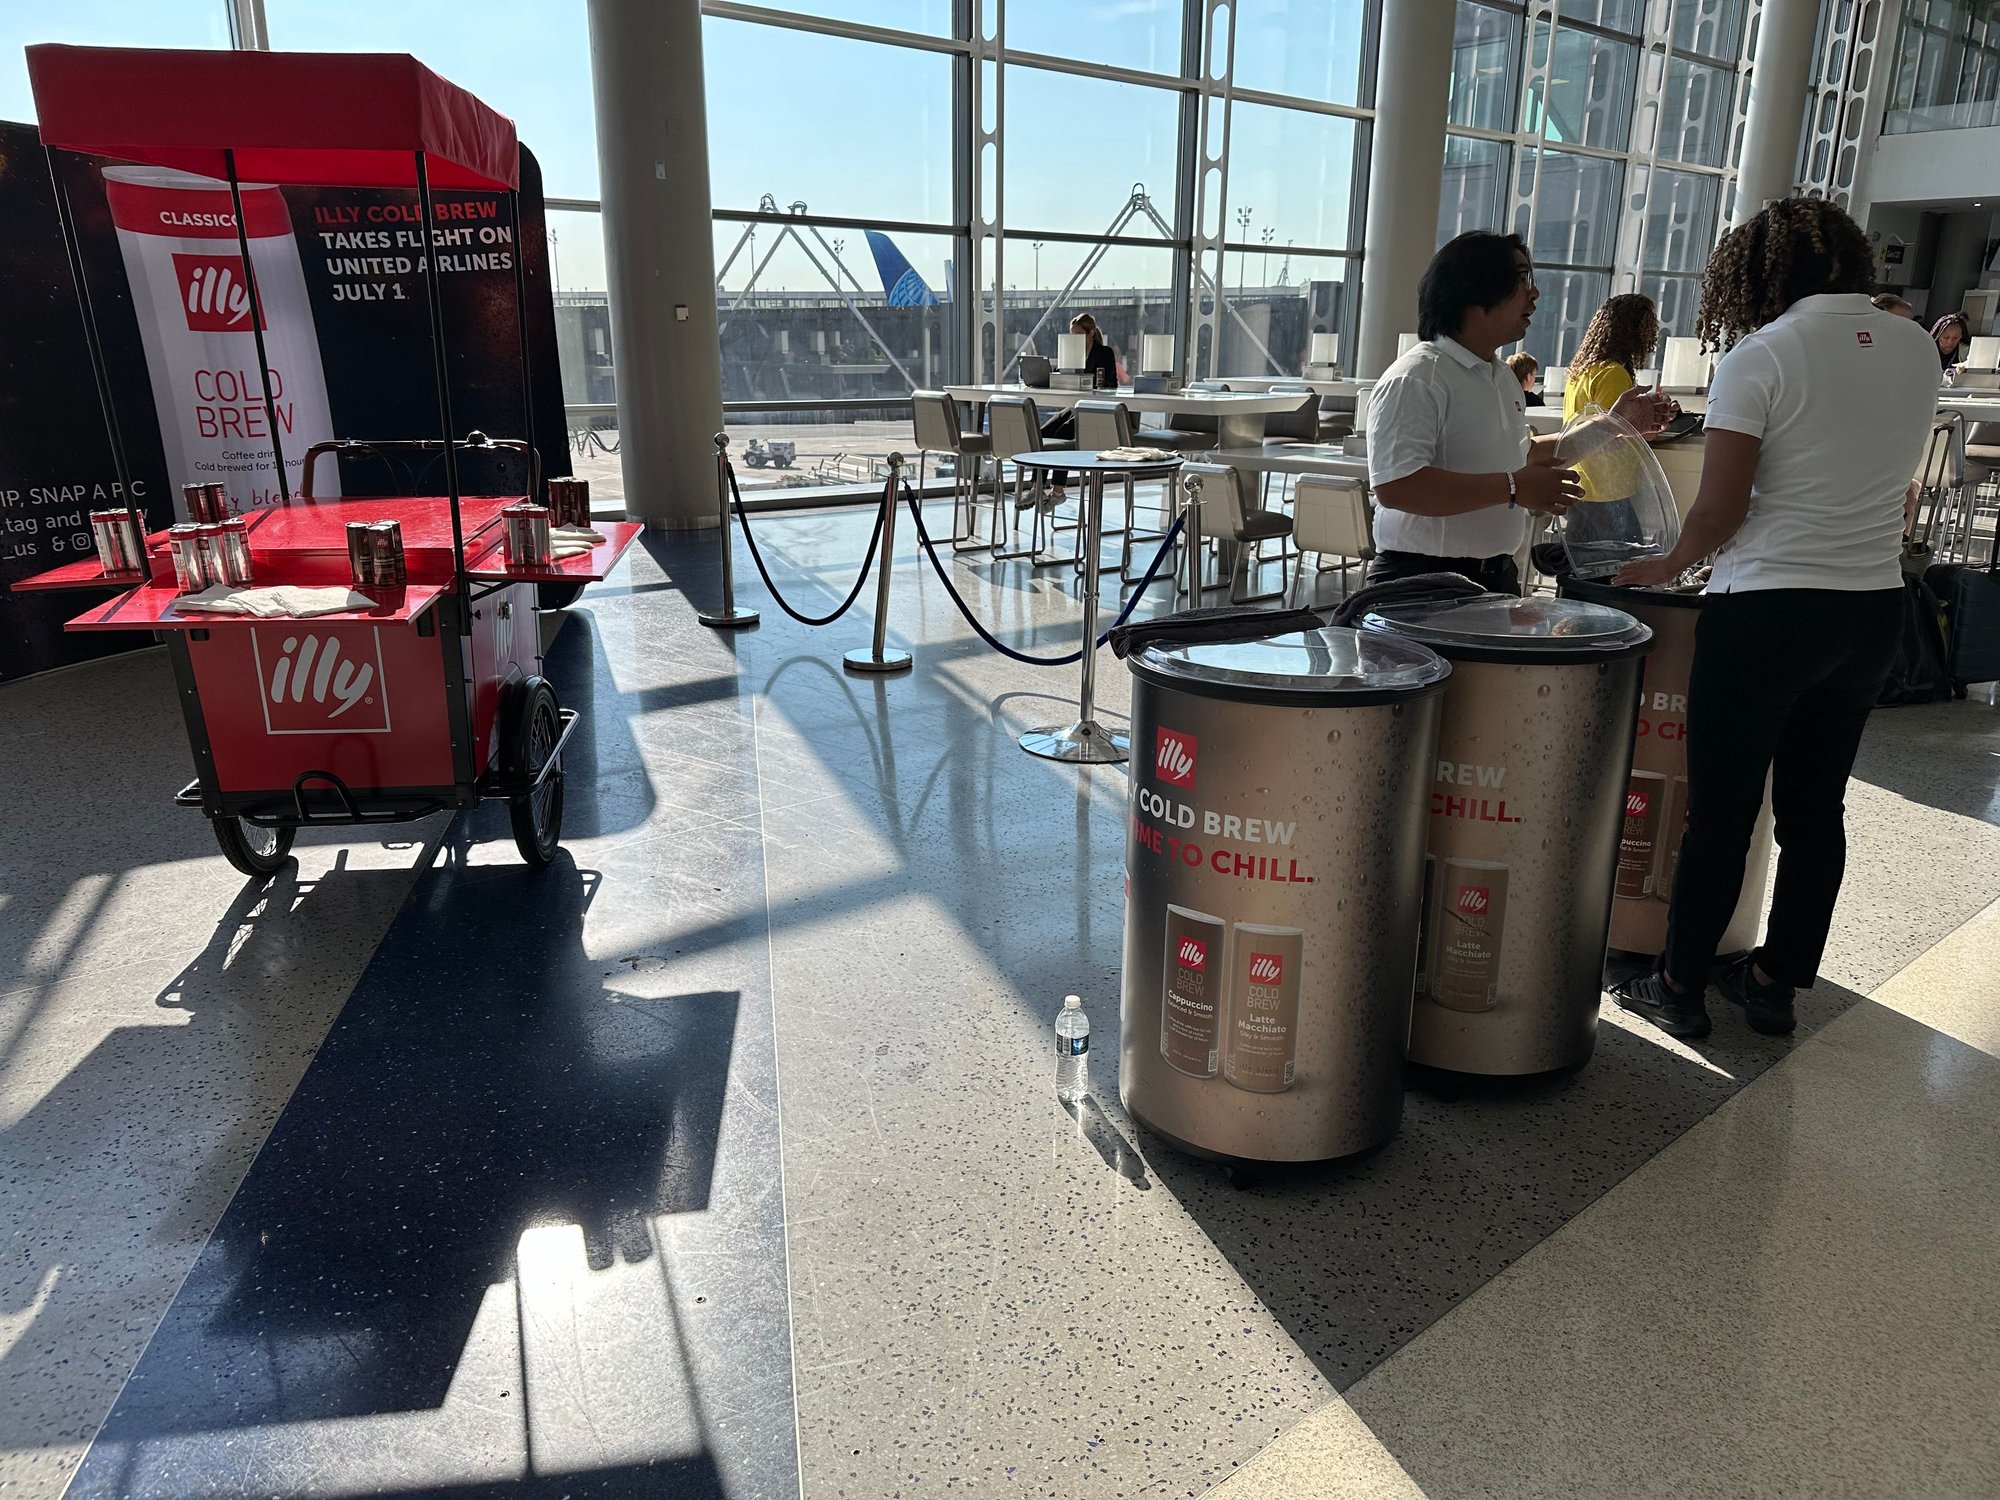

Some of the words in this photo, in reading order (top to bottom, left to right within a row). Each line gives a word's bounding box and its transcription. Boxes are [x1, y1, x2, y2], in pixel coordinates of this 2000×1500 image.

[314, 206, 361, 224] ILLY
[435, 201, 497, 221] BREW
[319, 231, 391, 250] TAKES
[479, 226, 512, 245] ON
[326, 257, 412, 276] UNITED
[417, 252, 513, 274] ARLINES
[187, 266, 251, 326] illy
[332, 283, 386, 301] JULY
[196, 403, 293, 439] BREW
[194, 461, 216, 472] Cold
[217, 462, 253, 472] brewed
[256, 462, 270, 471] for
[221, 450, 255, 460] Coffee
[29, 485, 86, 505] SNAP
[92, 483, 107, 500] A
[111, 480, 147, 499] PC
[45, 510, 82, 529] and
[270, 633, 375, 719] illy
[1157, 737, 1194, 780] illy
[1435, 759, 1507, 789] REW
[1139, 787, 1196, 829] COLD
[1203, 809, 1297, 846] BREW
[1167, 837, 1204, 868] TO
[1210, 849, 1314, 884] CHILL.
[1459, 889, 1487, 912] illy
[1180, 942, 1205, 967] illy
[1445, 945, 1492, 959] Macchiato
[1457, 940, 1481, 950] Latte
[1178, 967, 1204, 985] COLD
[1250, 958, 1281, 982] illy
[1176, 978, 1205, 996] BREW
[1249, 986, 1280, 1000] COLD
[1168, 989, 1214, 1012] Cappuccino
[1247, 996, 1280, 1011] BREW
[1238, 1019, 1287, 1034] Macchiato
[1249, 1013, 1276, 1024] Latte
